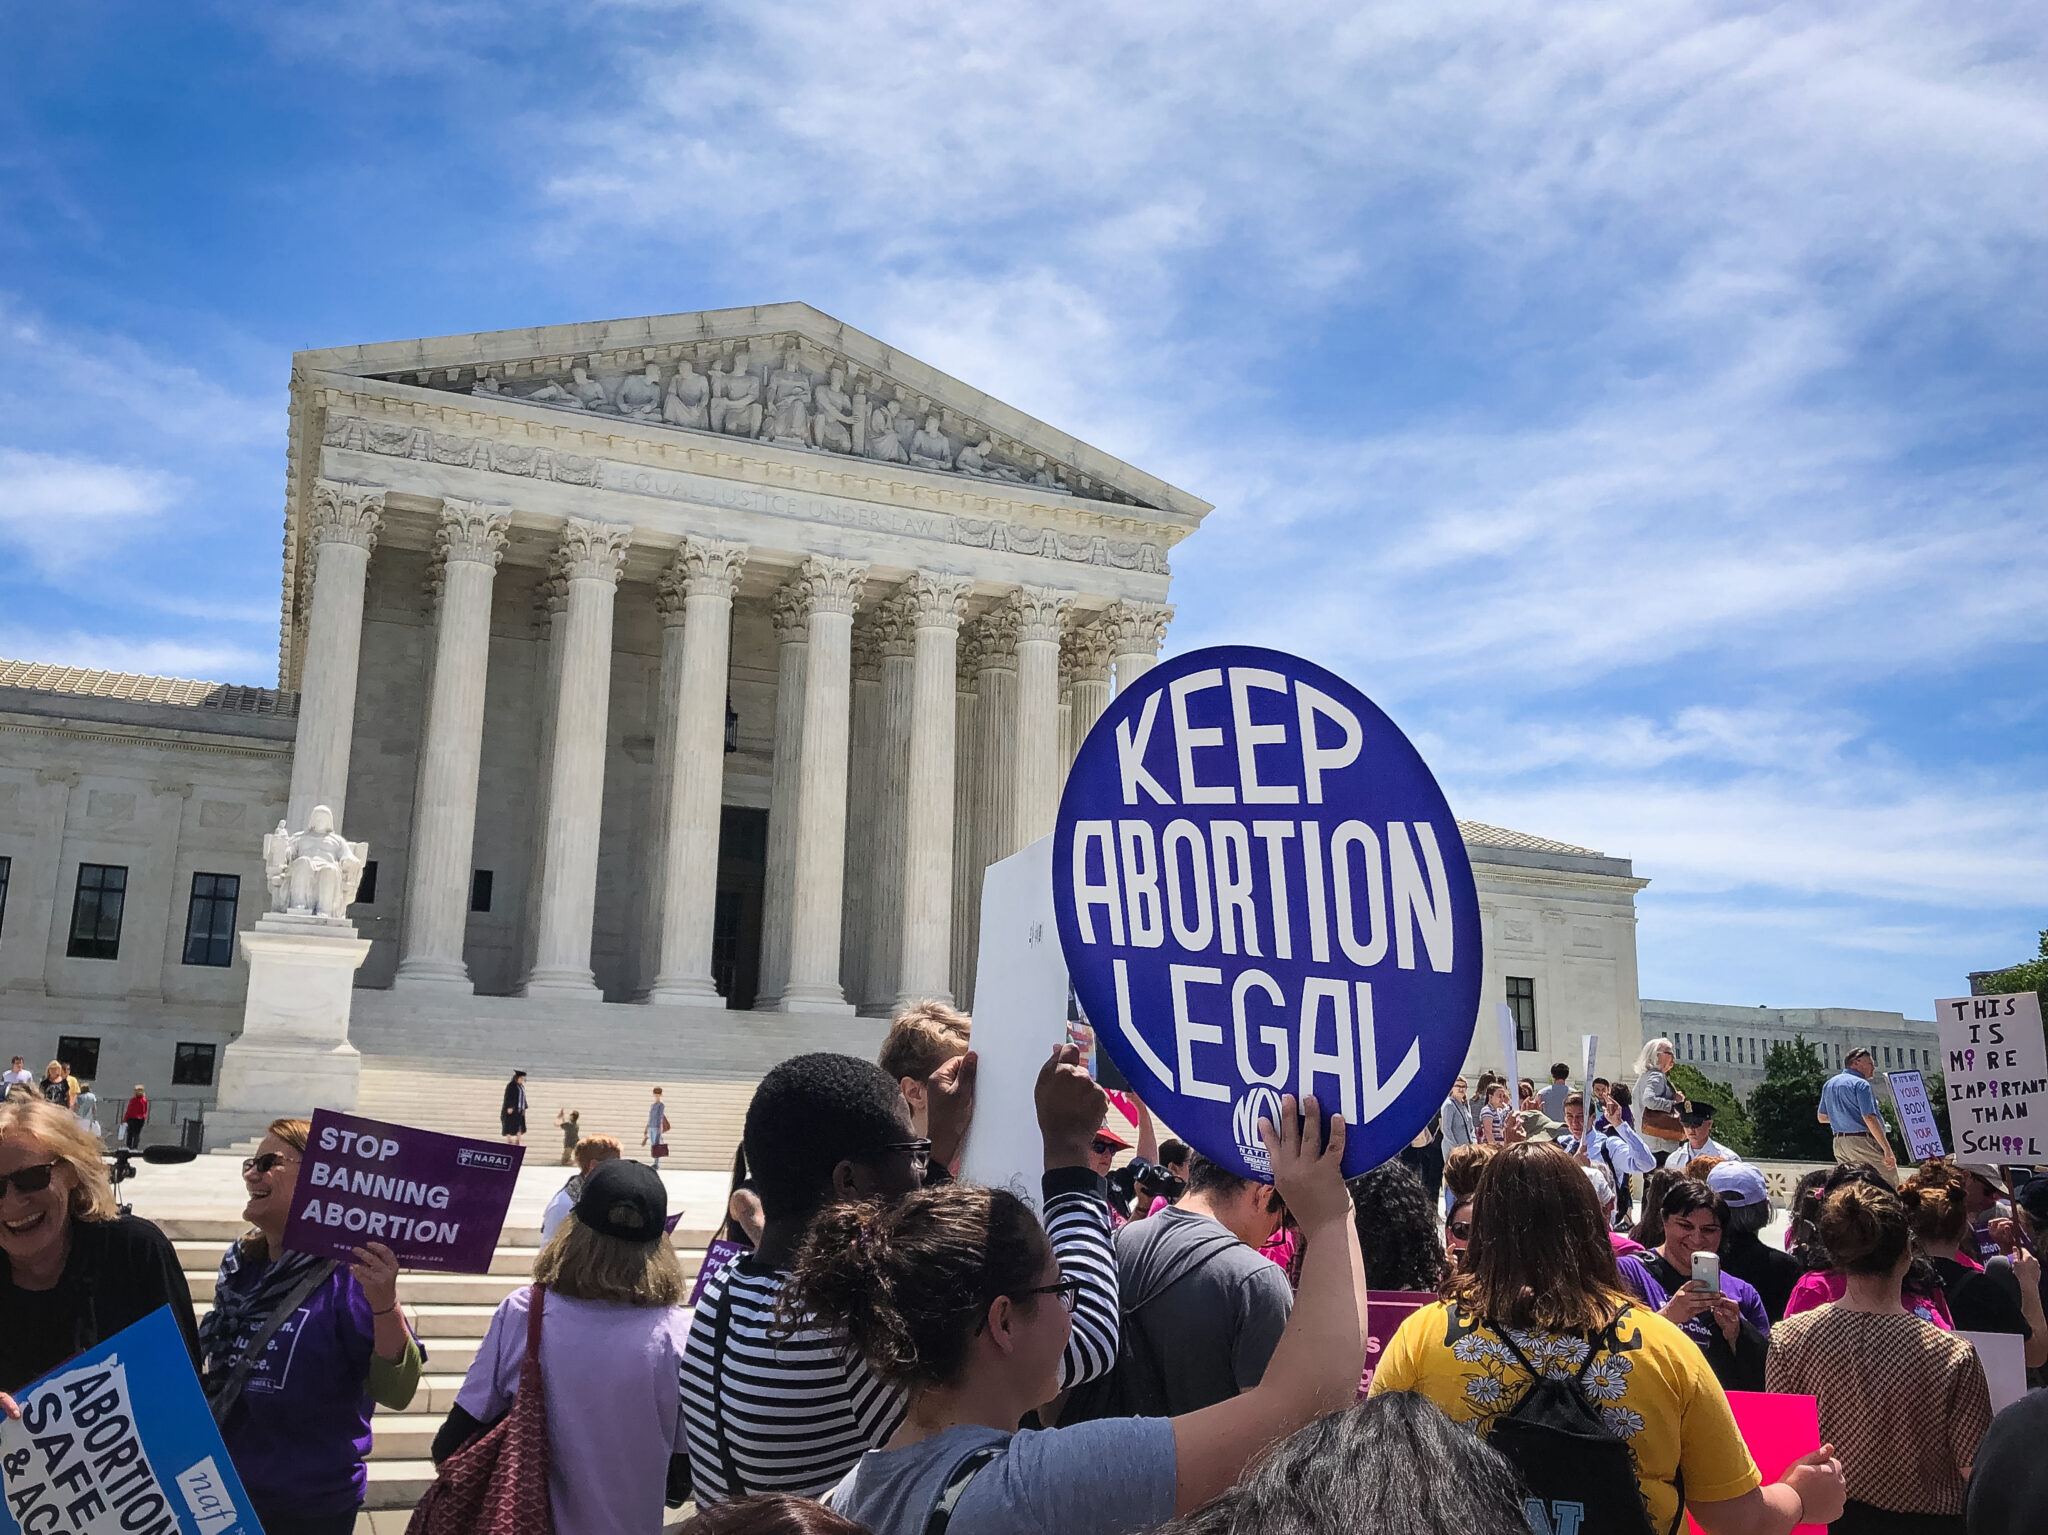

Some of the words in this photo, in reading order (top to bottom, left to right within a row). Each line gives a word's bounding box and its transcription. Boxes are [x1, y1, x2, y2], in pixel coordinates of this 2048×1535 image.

[620, 471, 700, 498] EQUAL
[706, 486, 796, 514] JUSTICE
[809, 501, 881, 527] UNDER
[892, 513, 934, 535] LAW
[1115, 667, 1363, 805] KEEP
[1073, 818, 1454, 973] ABORTION
[1951, 997, 2016, 1021] THIS
[1114, 959, 1420, 1125] LEGAL
[1968, 1023, 2005, 1044] IS
[1900, 1086, 1921, 1098] YOUR
[1904, 1101, 1926, 1115] BODY
[1971, 1102, 2028, 1124] THAN
[319, 1127, 400, 1161] STOP
[1913, 1127, 1933, 1140] YOUR
[1916, 1141, 1942, 1156] CHOICE
[474, 1154, 508, 1166] NARAL
[310, 1162, 451, 1209] BANNING
[301, 1199, 460, 1244] ABORTION
[3, 1448, 31, 1483] &
[23, 1392, 107, 1530] SAFE
[189, 1472, 238, 1521] naf
